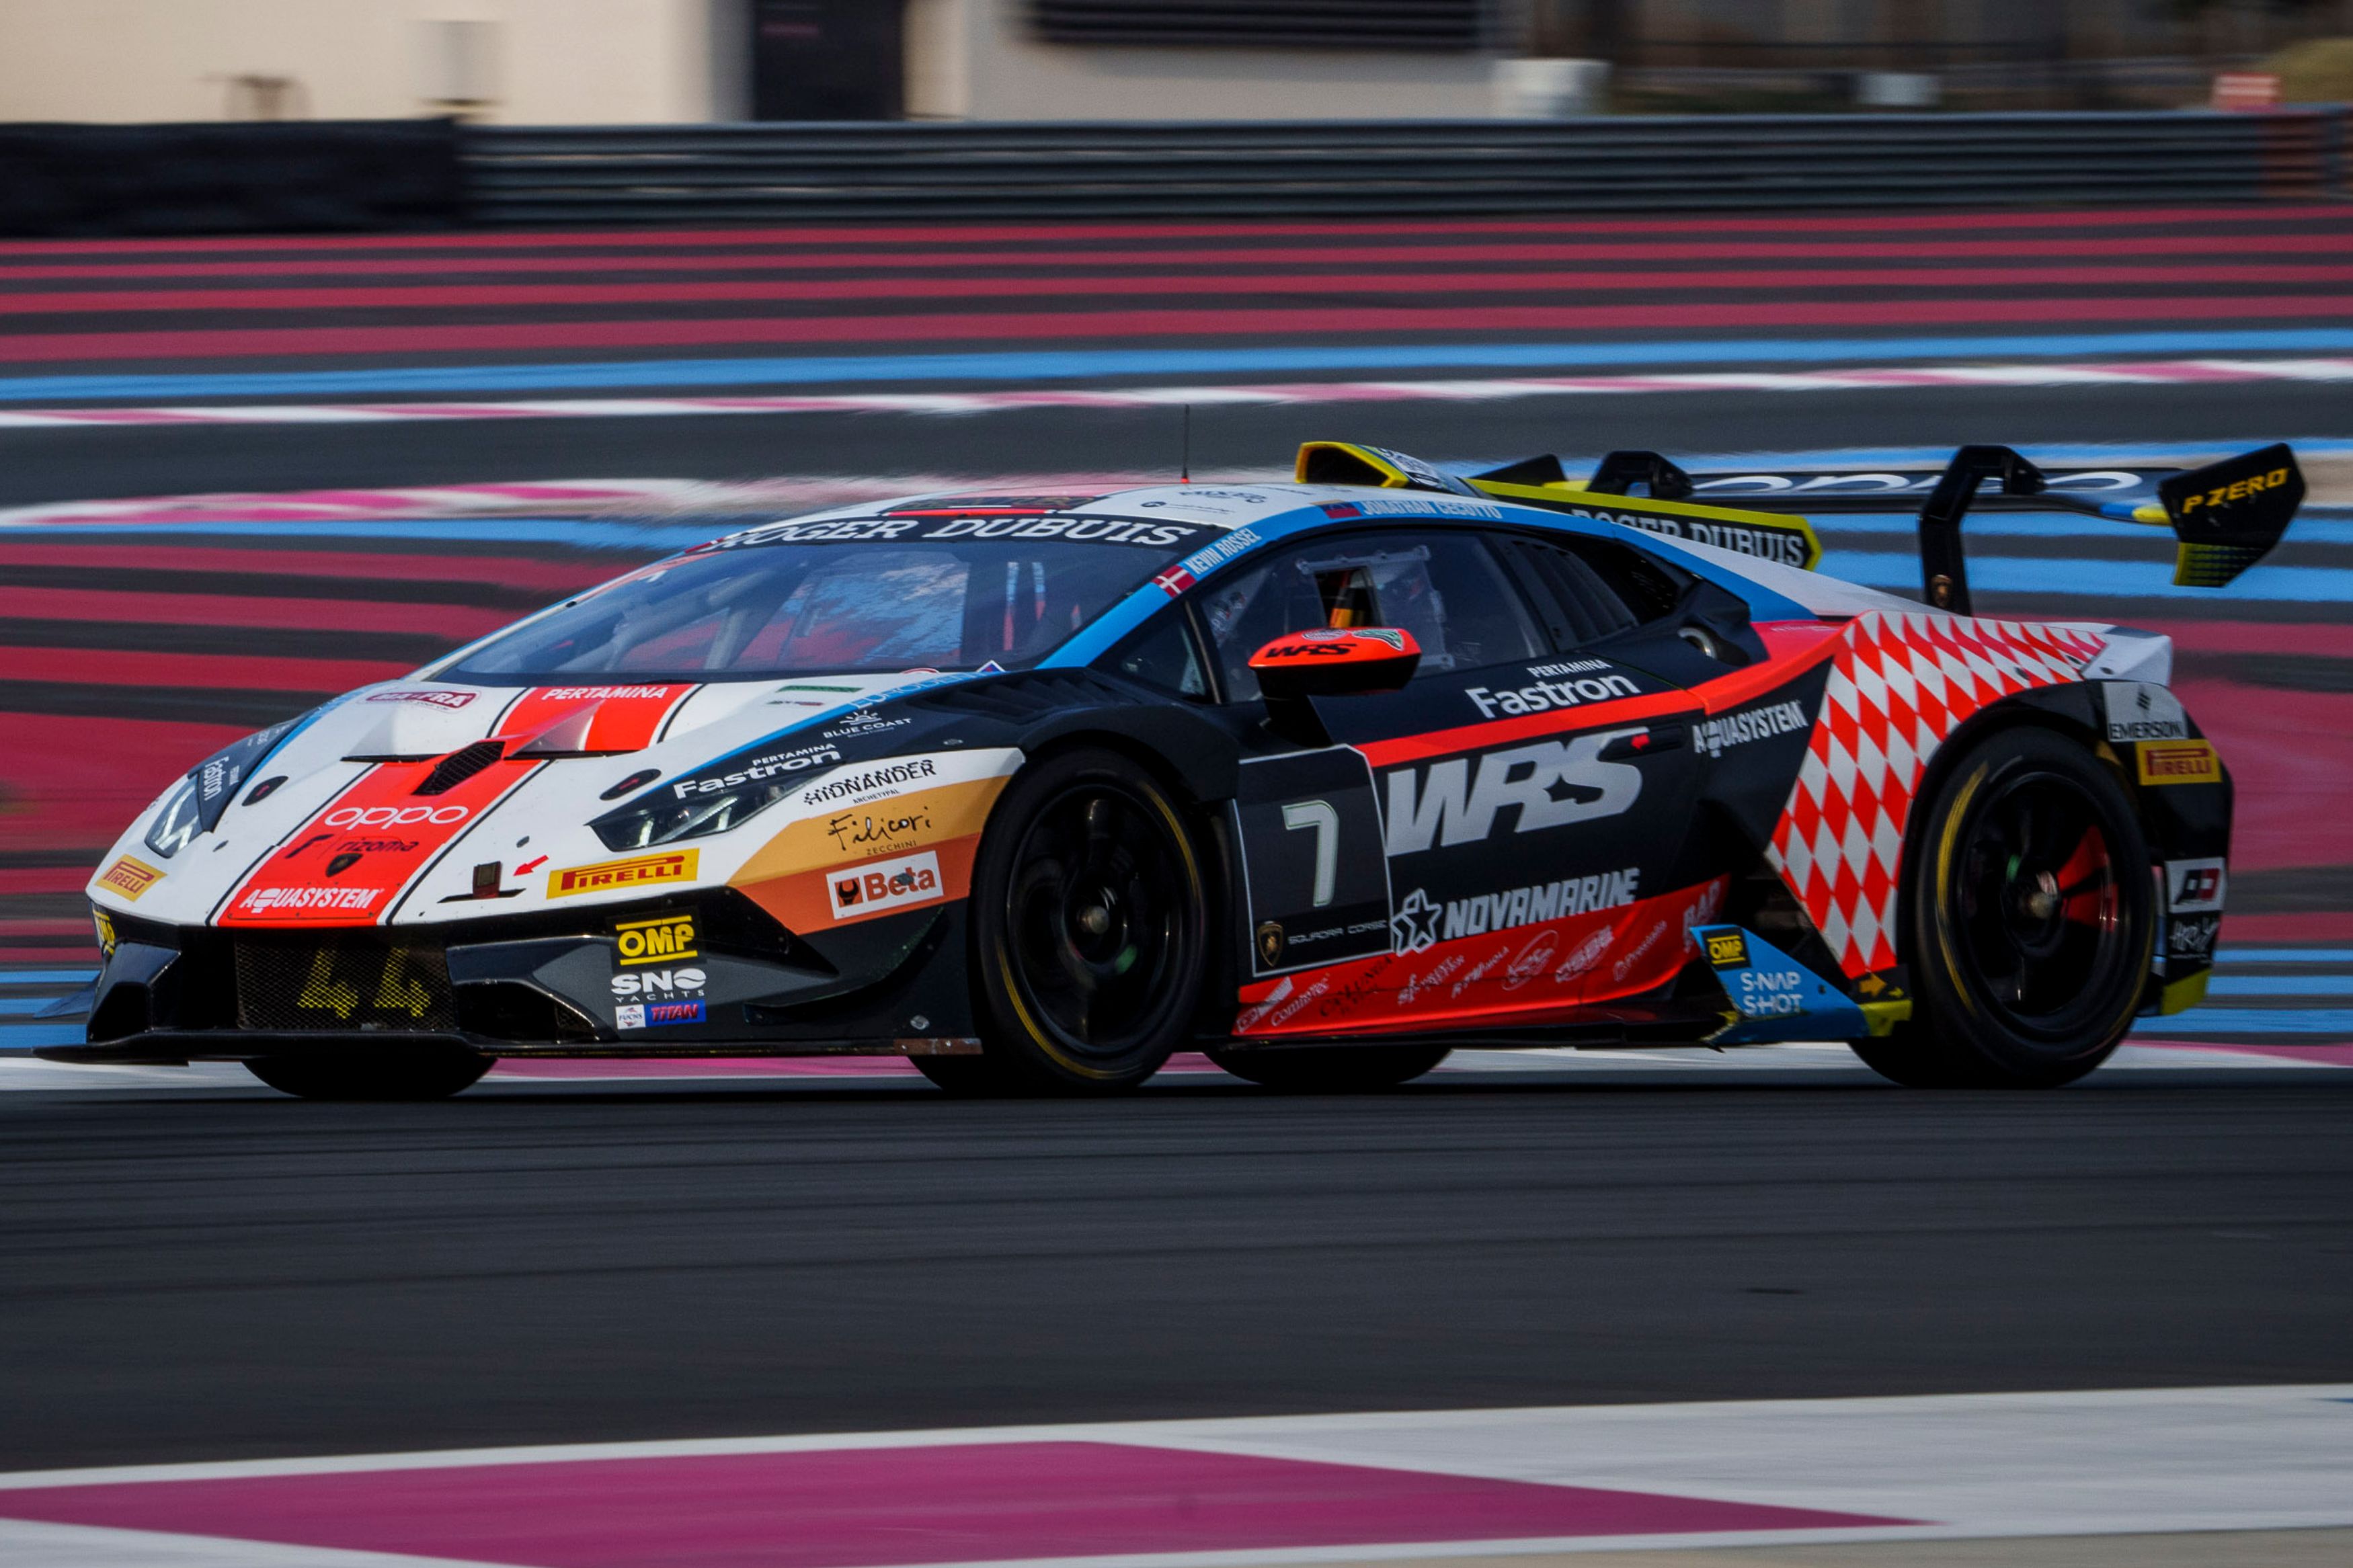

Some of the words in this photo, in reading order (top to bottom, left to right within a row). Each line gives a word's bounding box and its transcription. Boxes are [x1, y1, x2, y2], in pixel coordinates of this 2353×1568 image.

[2182, 495, 2204, 513] P
[2206, 468, 2290, 506] ZERO
[1359, 500, 1437, 515] JONATHAN
[922, 518, 1198, 545] DUBUIS
[1183, 543, 1224, 575] KEVIN
[1265, 643, 1358, 658] WRS
[1526, 659, 1613, 678] PERTAMINA
[542, 686, 670, 700] PERTAMINA
[1464, 674, 1642, 719] Fastron
[822, 725, 861, 739] BLUE
[861, 718, 913, 731] COAST
[2109, 721, 2184, 739] EMERSON
[752, 743, 837, 766] PERTAMINA
[672, 750, 842, 800] Fastron
[1386, 726, 1650, 858] WRS
[324, 805, 469, 830] oppo
[827, 806, 932, 852] Filicori
[335, 840, 420, 852] rizoma
[866, 840, 918, 856] ZECCHINI
[1281, 800, 1340, 907] 7
[103, 860, 156, 893] PIRELLI
[560, 855, 685, 891] PIRELLI
[863, 867, 936, 902] Beta
[1442, 868, 1641, 940] NOVAMARINE
[618, 923, 695, 957] OMP
[1709, 940, 1744, 960] OMP
[1740, 971, 1802, 992] SNAP
[615, 989, 705, 1003] YACHTS
[1743, 993, 1804, 1014] SHOT
[651, 1004, 699, 1022] TITAN
